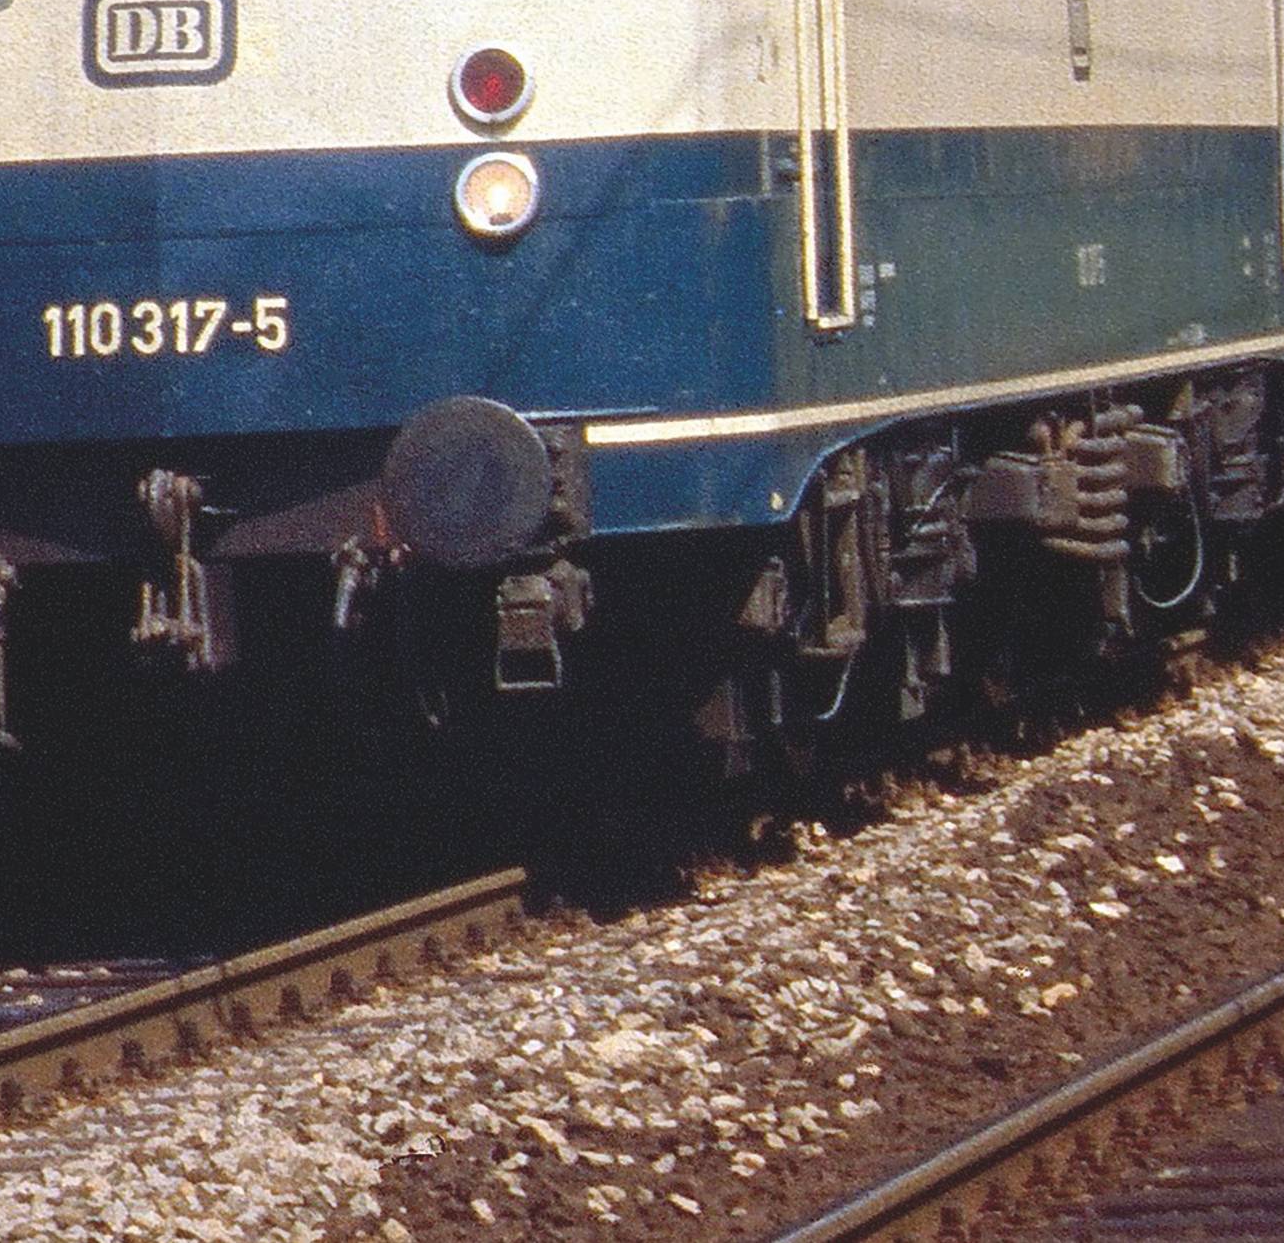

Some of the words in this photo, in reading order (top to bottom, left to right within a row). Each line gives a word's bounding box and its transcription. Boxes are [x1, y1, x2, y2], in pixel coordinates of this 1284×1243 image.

[110, 5, 205, 57] DB
[43, 302, 122, 358] 110
[131, 296, 288, 355] 317-5
